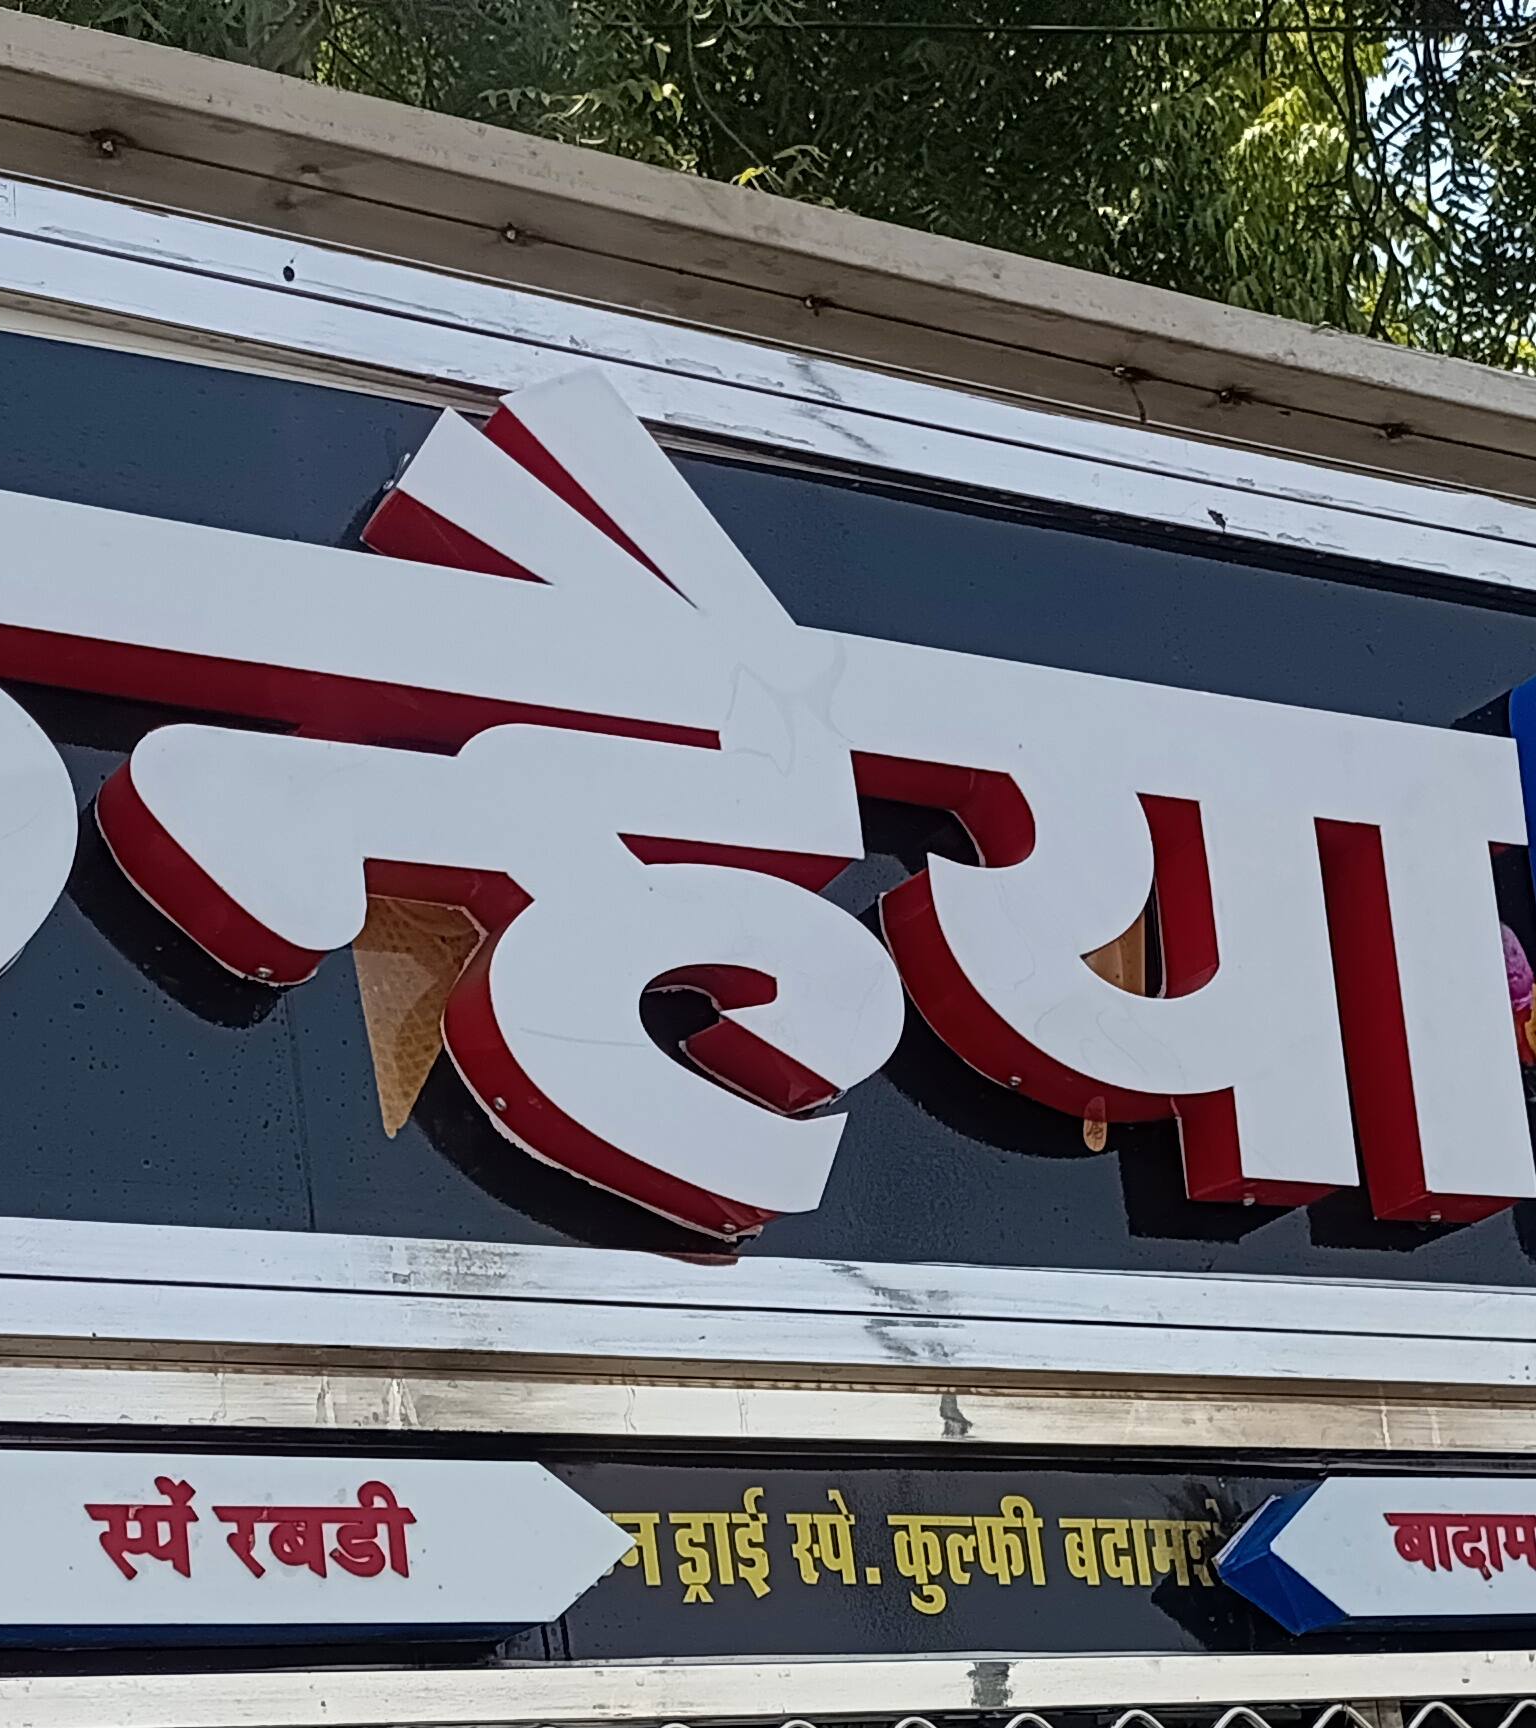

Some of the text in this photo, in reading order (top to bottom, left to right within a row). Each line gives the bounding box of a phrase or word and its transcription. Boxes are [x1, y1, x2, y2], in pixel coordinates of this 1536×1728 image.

[212, 1481, 417, 1579] रबडी
[668, 1487, 771, 1603] ड्राई
[887, 1495, 1046, 1615] कुल्फी
